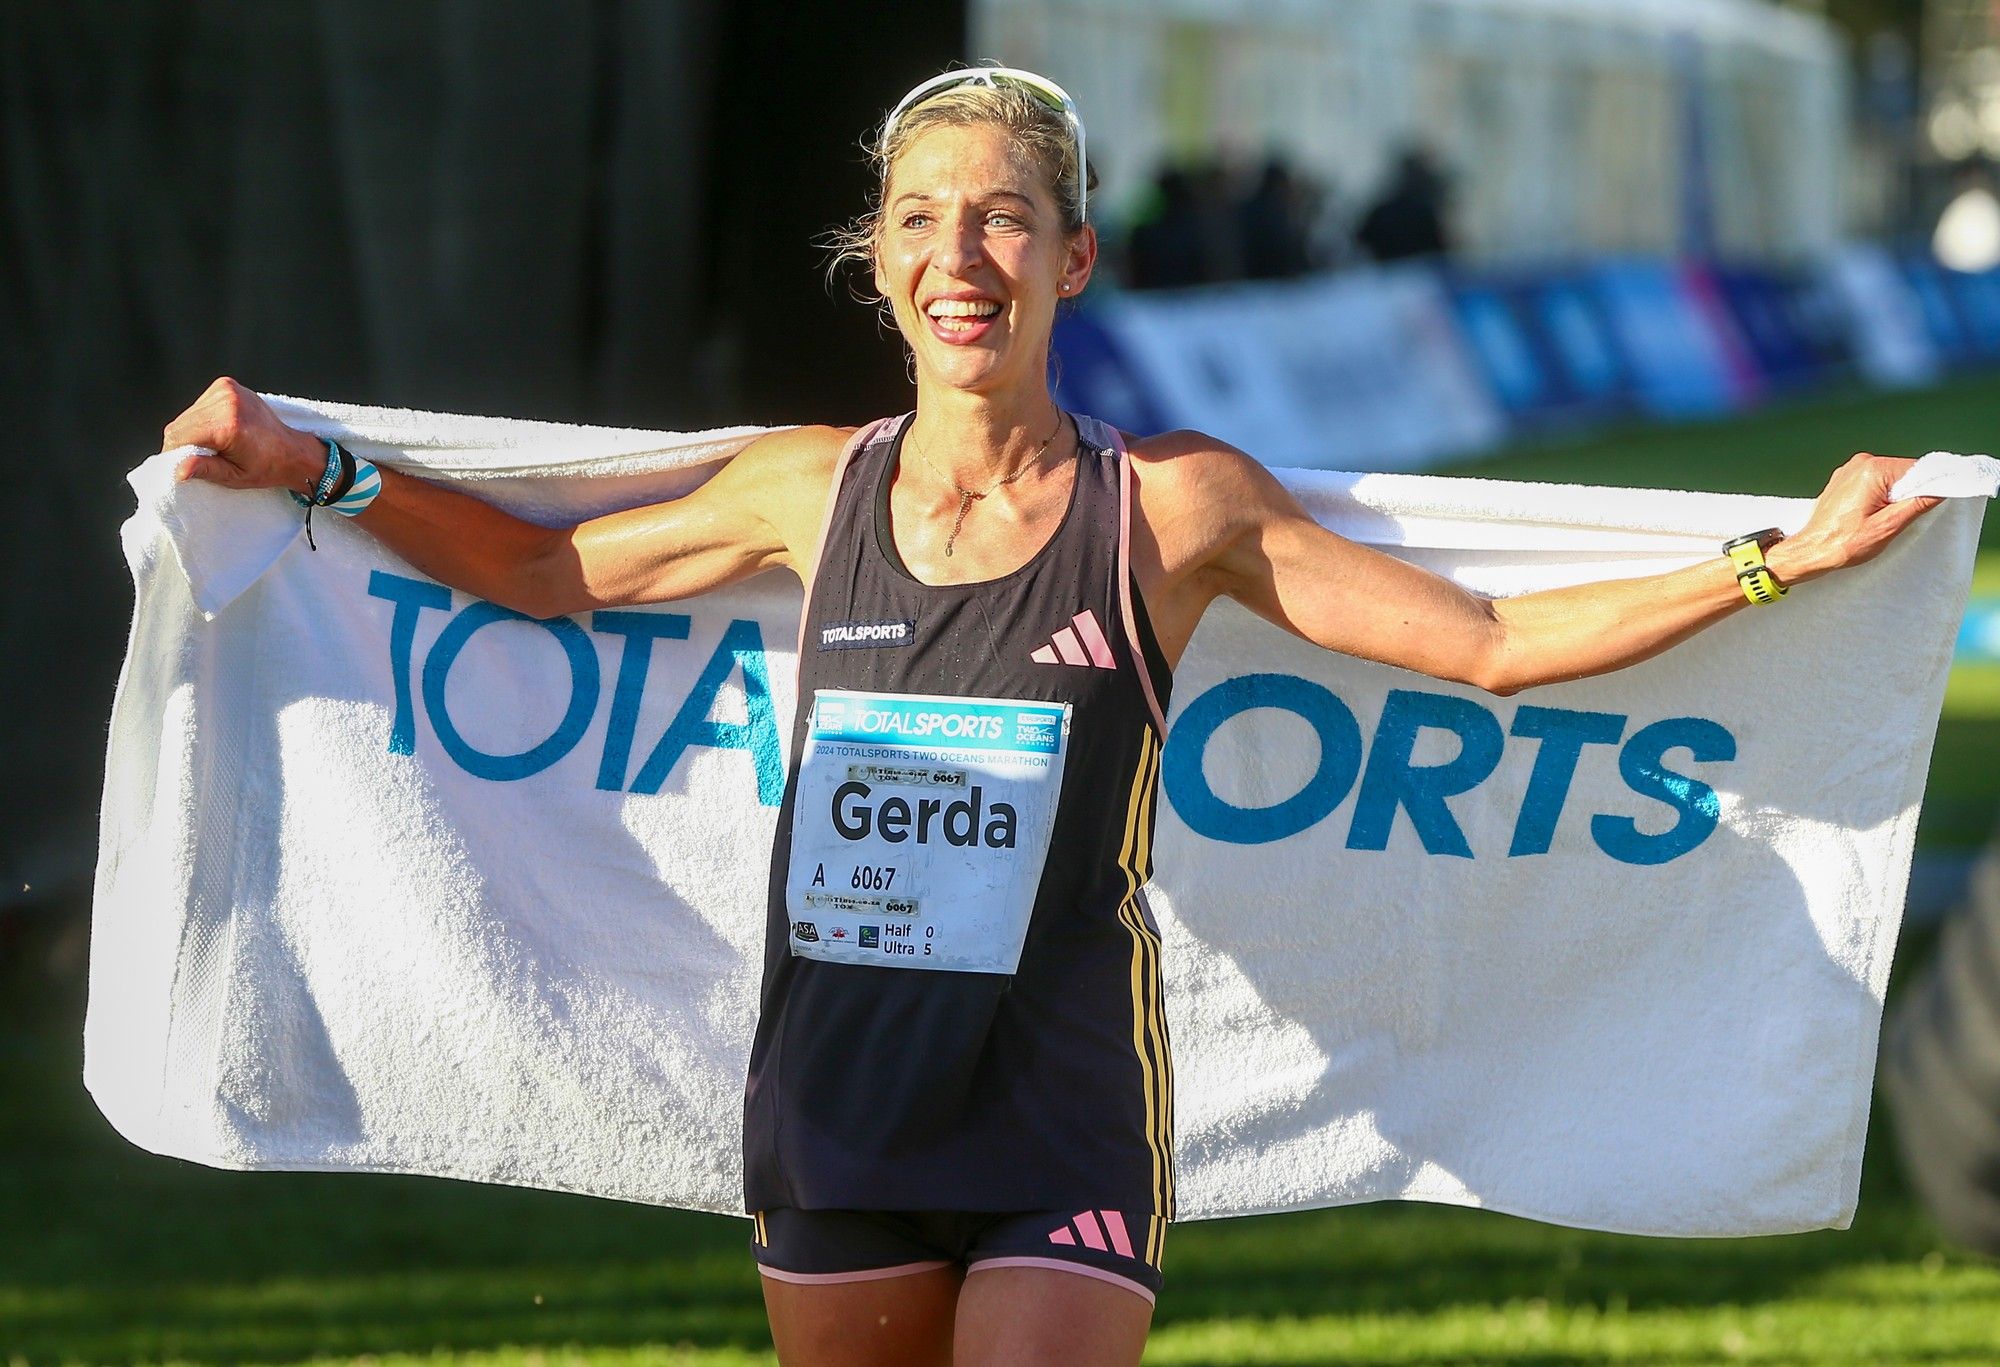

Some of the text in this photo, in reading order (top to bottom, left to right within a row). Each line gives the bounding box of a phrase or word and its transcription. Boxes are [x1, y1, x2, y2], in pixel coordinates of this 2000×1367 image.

[822, 623, 906, 644] TOTALSPORTS
[368, 570, 1737, 866] TOTAORTS
[852, 709, 1004, 740] TOTALSPORTS
[1016, 733, 1055, 743] OCEANS
[816, 746, 1048, 767] 2024 TOTALSPORTS TWO OCEANS MARATHON
[933, 772, 961, 784] 6067
[832, 781, 1017, 849] Gerda
[811, 863, 896, 891] A 6067
[886, 902, 913, 914] 6067
[798, 923, 816, 935] ASA
[885, 924, 934, 939] Half 0
[884, 941, 932, 956] Ultra 5
